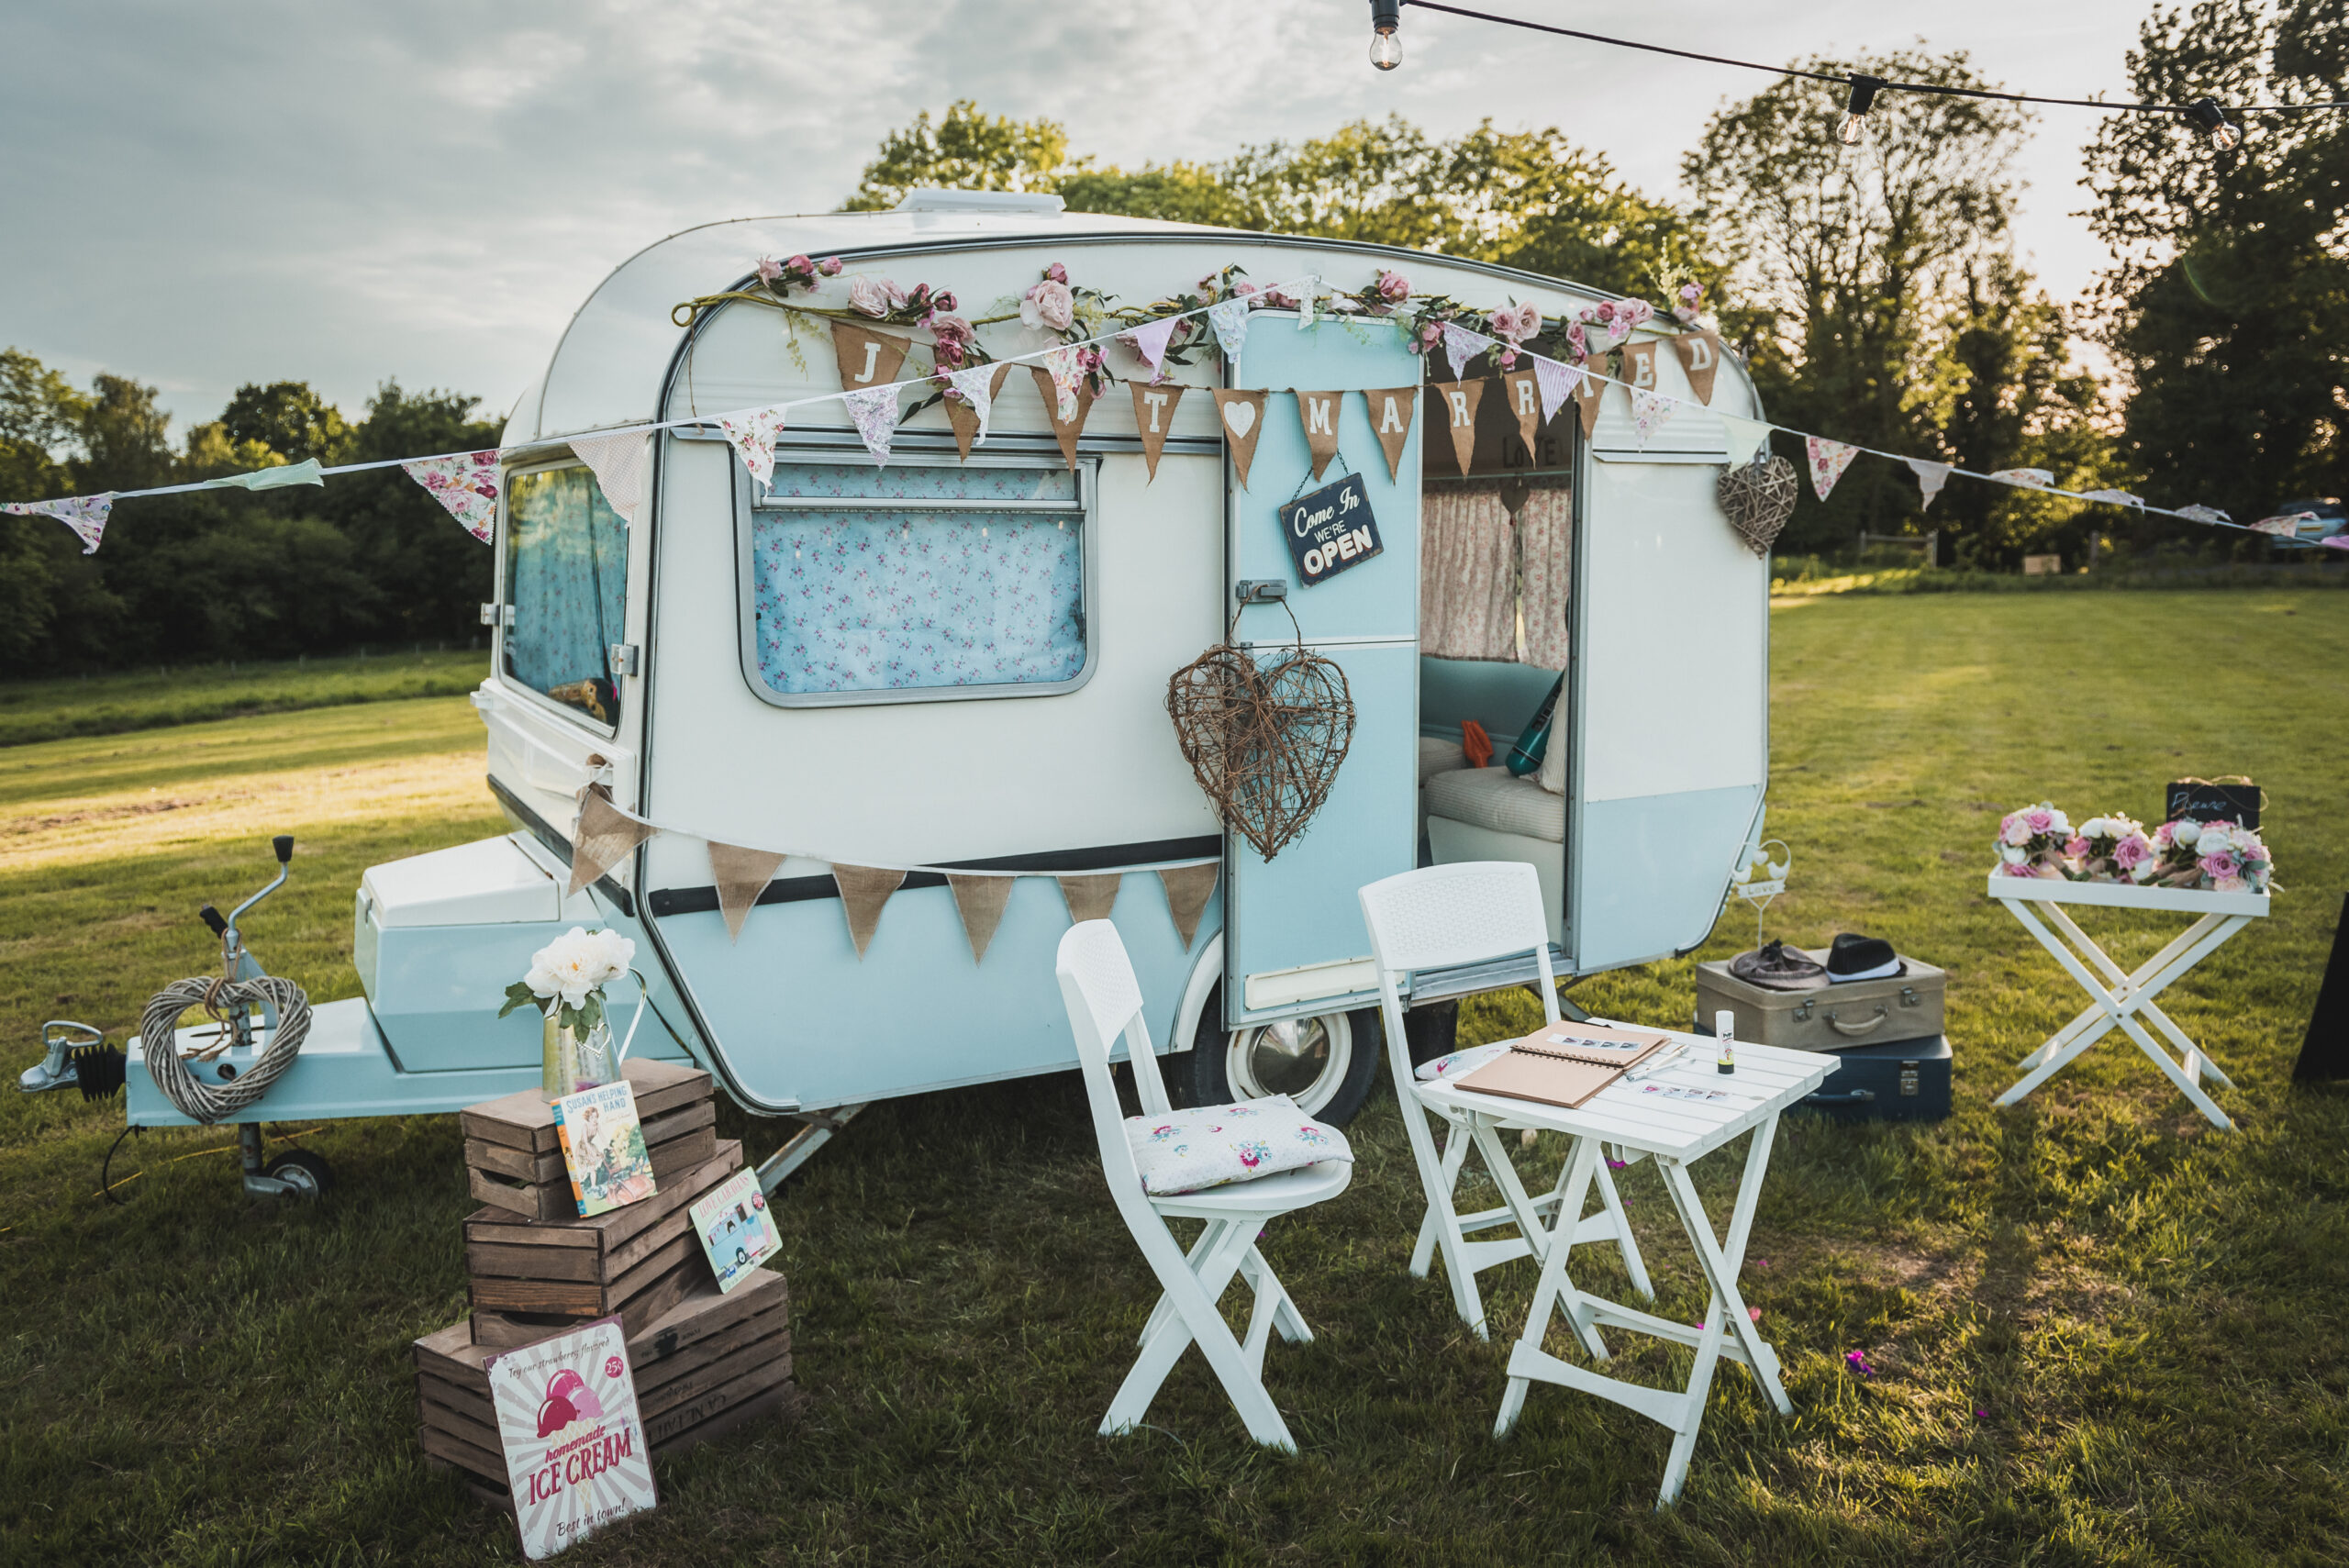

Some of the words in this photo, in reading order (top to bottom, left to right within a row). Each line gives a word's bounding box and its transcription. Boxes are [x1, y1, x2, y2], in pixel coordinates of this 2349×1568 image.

[1294, 506, 1335, 538] Come
[1340, 486, 1360, 515] In
[1314, 520, 1347, 543] WE'RE
[1304, 524, 1374, 576] OPEN
[598, 1085, 628, 1103] HELPING
[603, 1097, 627, 1113] HAND
[508, 1367, 522, 1380] Try
[538, 1349, 580, 1370] strawberry
[545, 1424, 607, 1463] homemade
[529, 1461, 562, 1506] ICE
[565, 1427, 633, 1485] CREAM
[556, 1517, 580, 1537] Best
[584, 1514, 594, 1525] in
[597, 1496, 626, 1521] town!
